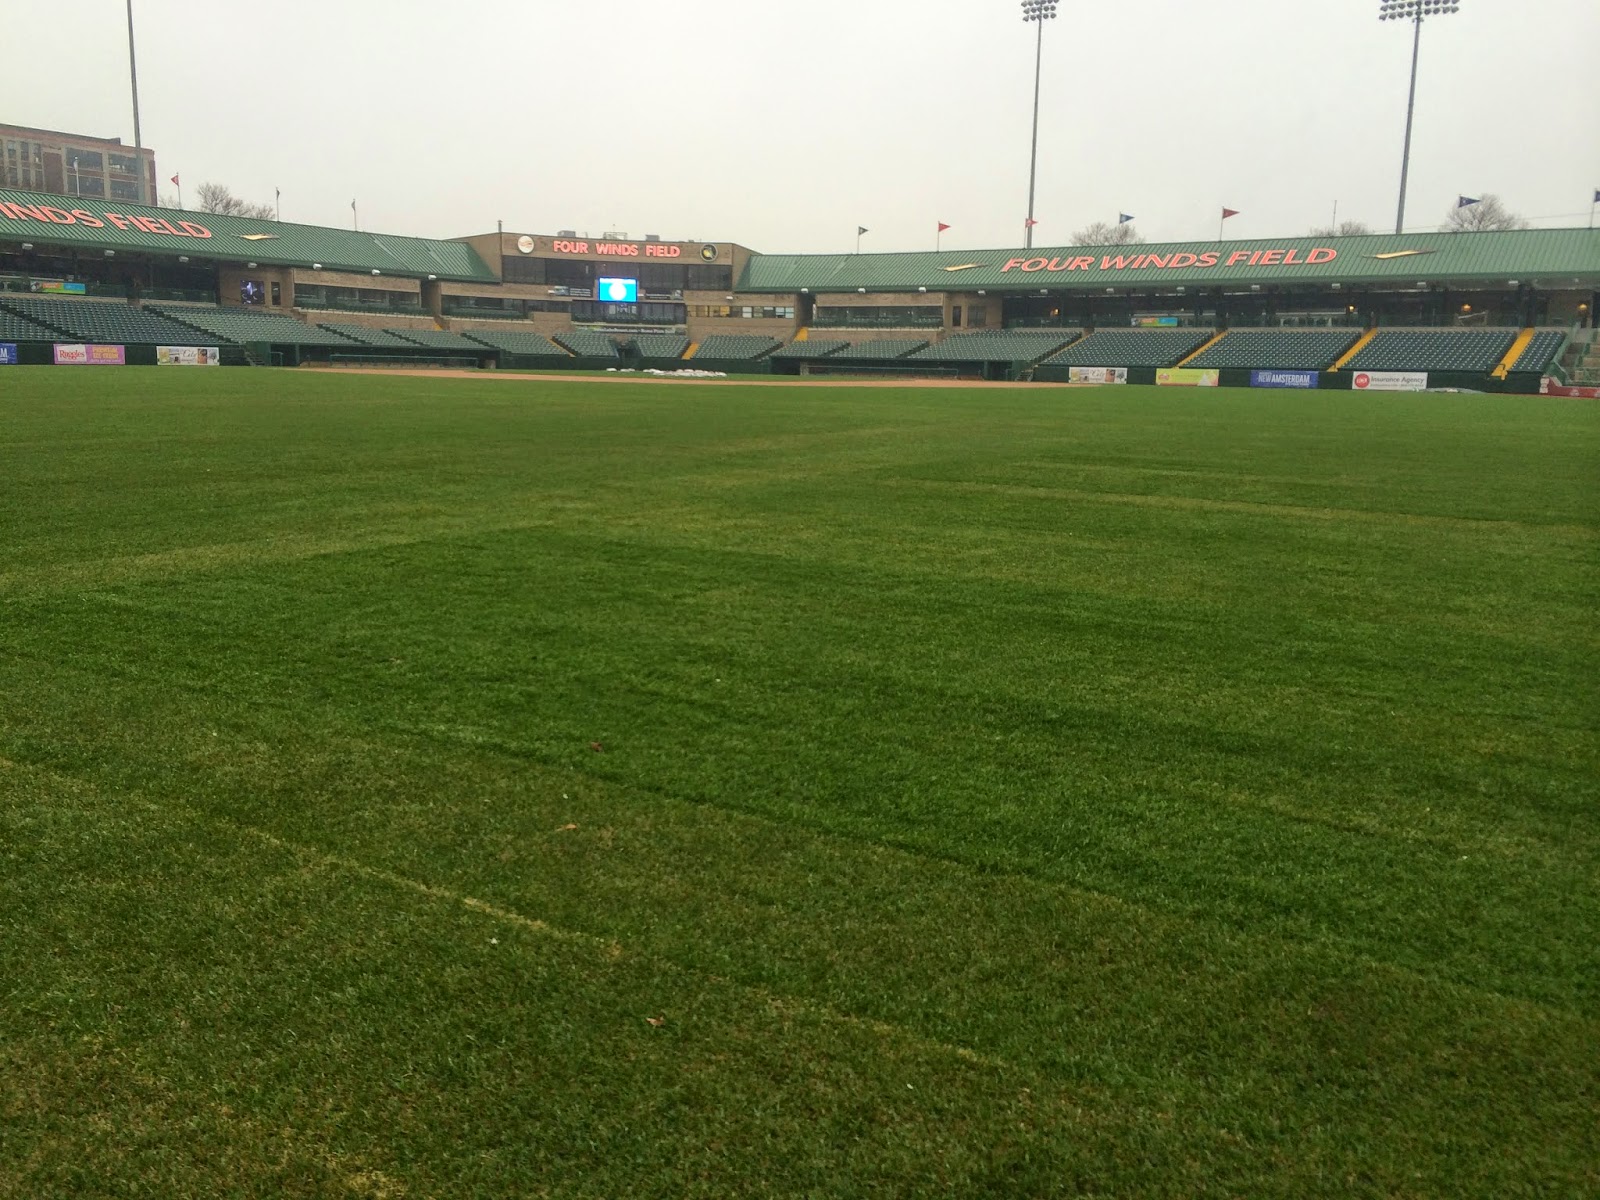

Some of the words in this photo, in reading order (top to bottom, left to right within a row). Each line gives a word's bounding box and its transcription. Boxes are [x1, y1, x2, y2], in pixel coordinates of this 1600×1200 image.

[0, 202, 104, 228] INDS
[104, 212, 212, 239] FIELD
[553, 240, 588, 254] FOUR
[596, 243, 638, 256] WINDS
[645, 245, 681, 257] FIELD
[1000, 255, 1095, 272] FOUR
[1100, 252, 1220, 270] WINDS
[1226, 248, 1337, 266] FIELD
[59, 350, 85, 359] Ruggles
[1258, 374, 1271, 382] NEW
[1271, 375, 1310, 383] AMSTERDAM
[1401, 376, 1424, 384] Agency
